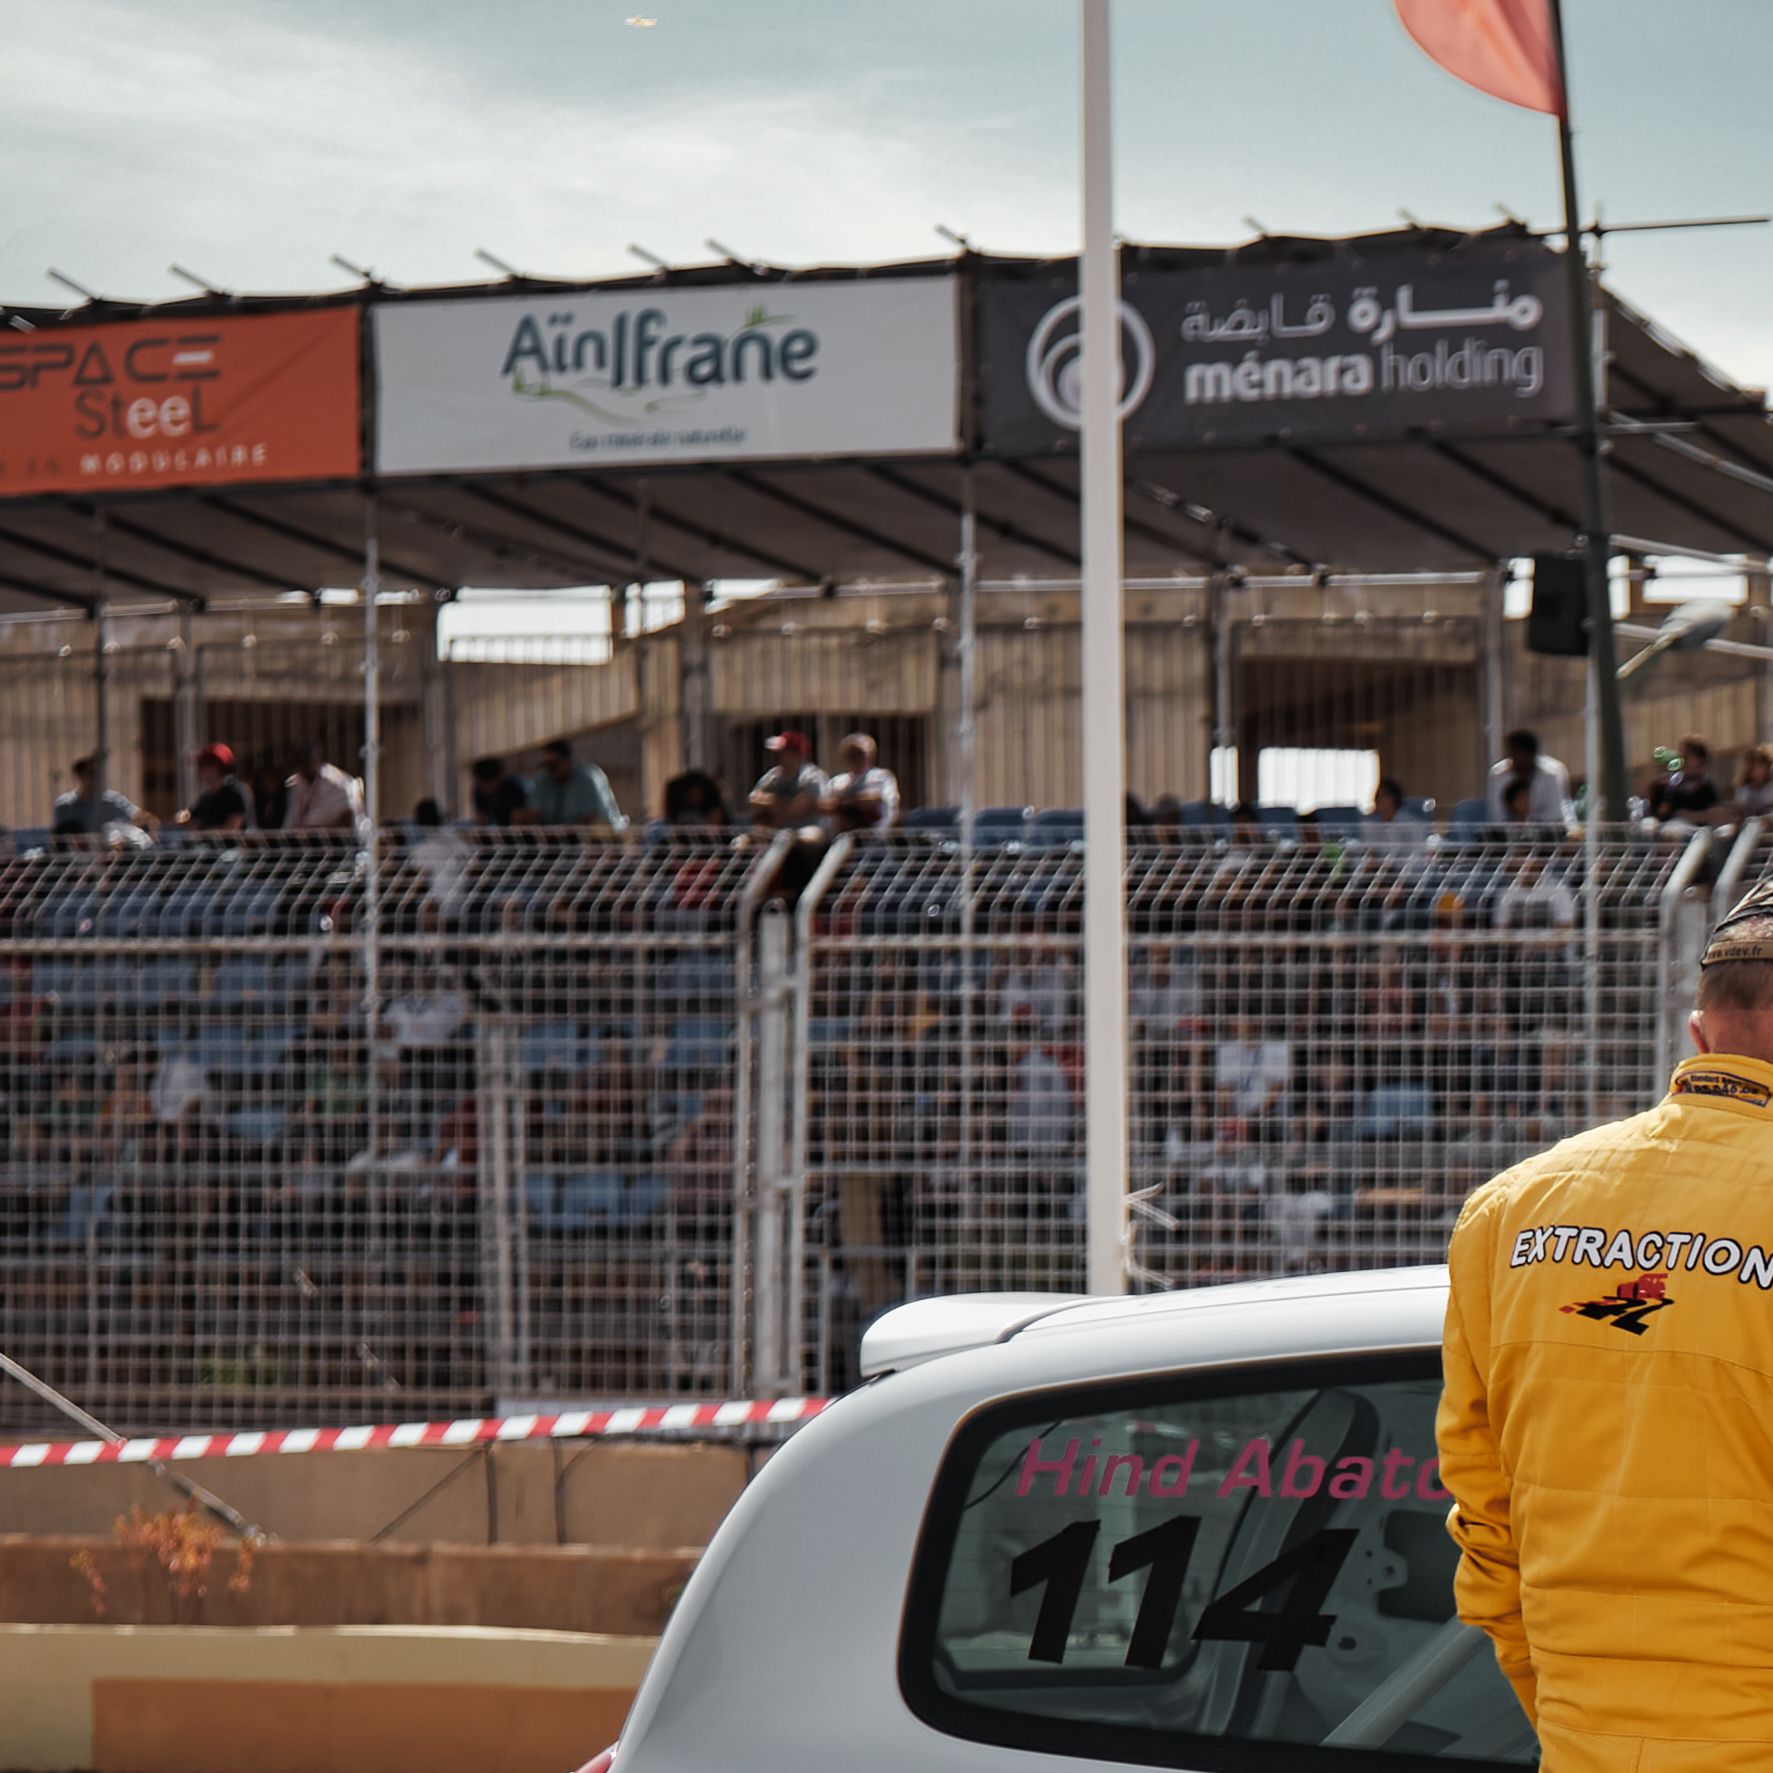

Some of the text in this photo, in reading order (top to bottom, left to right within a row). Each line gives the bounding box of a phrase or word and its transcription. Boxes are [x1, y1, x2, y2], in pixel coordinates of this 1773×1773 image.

[1184, 337, 1544, 404] ménara holding
[80, 444, 269, 475] MODULAIRE
[1014, 1438, 1199, 1499] Hind
[1010, 1515, 1361, 1672] 114
